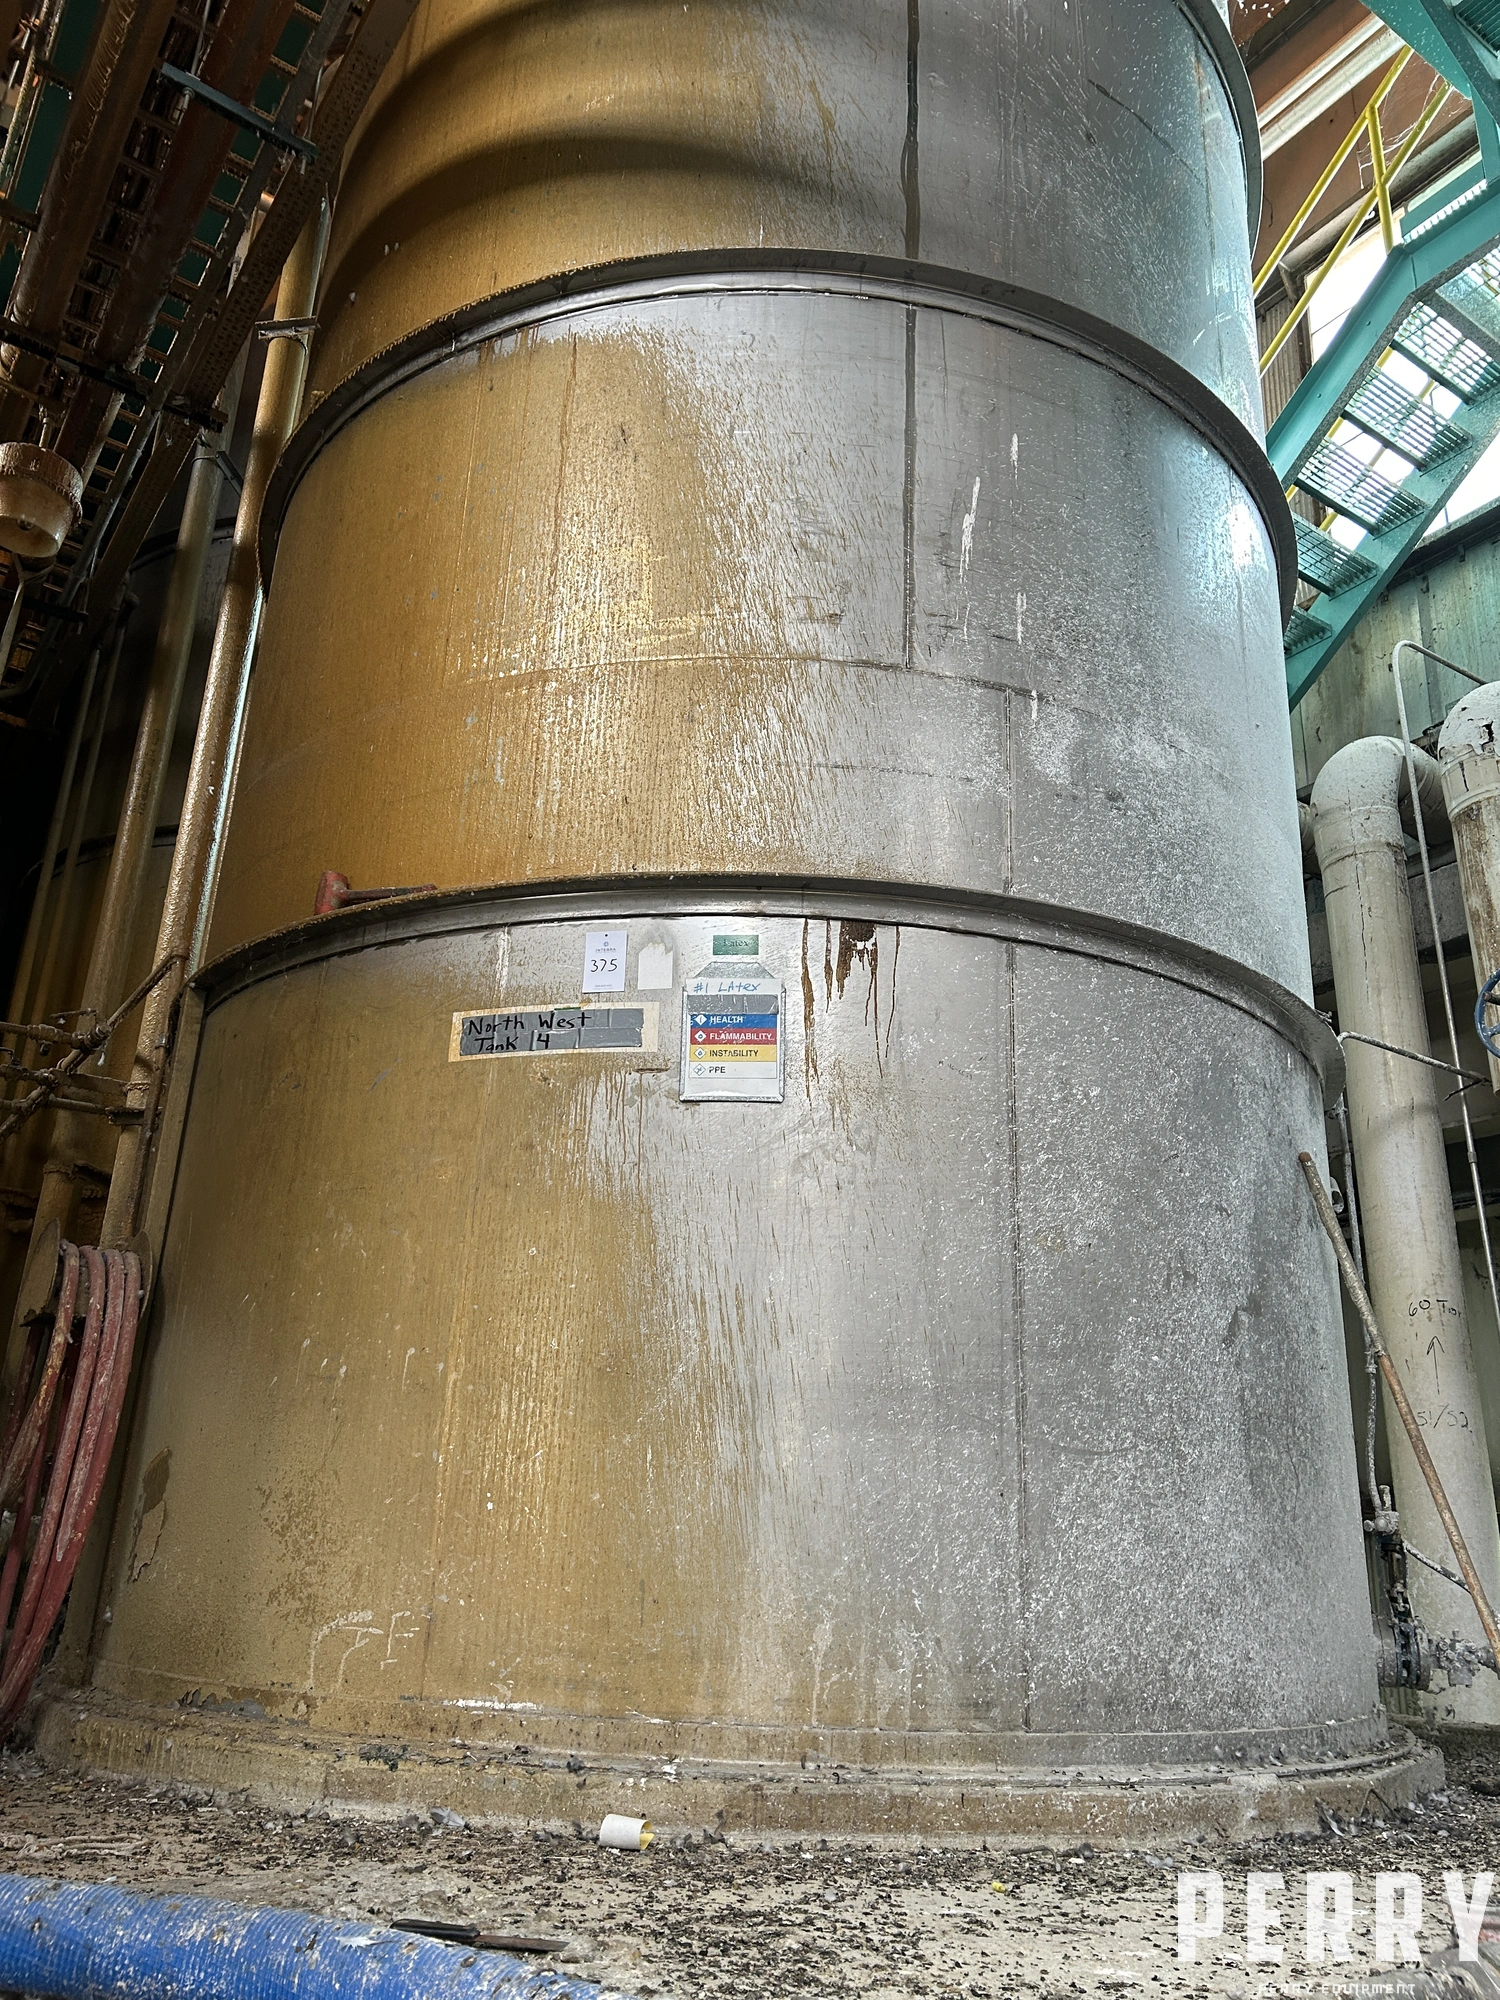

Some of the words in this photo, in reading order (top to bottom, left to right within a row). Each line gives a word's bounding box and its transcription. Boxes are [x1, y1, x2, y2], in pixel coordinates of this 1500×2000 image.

[590, 958, 618, 973] 375
[693, 982, 709, 994] #1
[468, 1014, 525, 1037] North
[538, 1008, 593, 1030] West
[709, 1015, 744, 1024] HEALTH
[709, 1032, 773, 1041] FLAMMABILITY
[473, 1036, 519, 1054] Tank
[536, 1033, 551, 1050] 4
[709, 1049, 759, 1058] INSTABILITY
[708, 1066, 726, 1074] PPE
